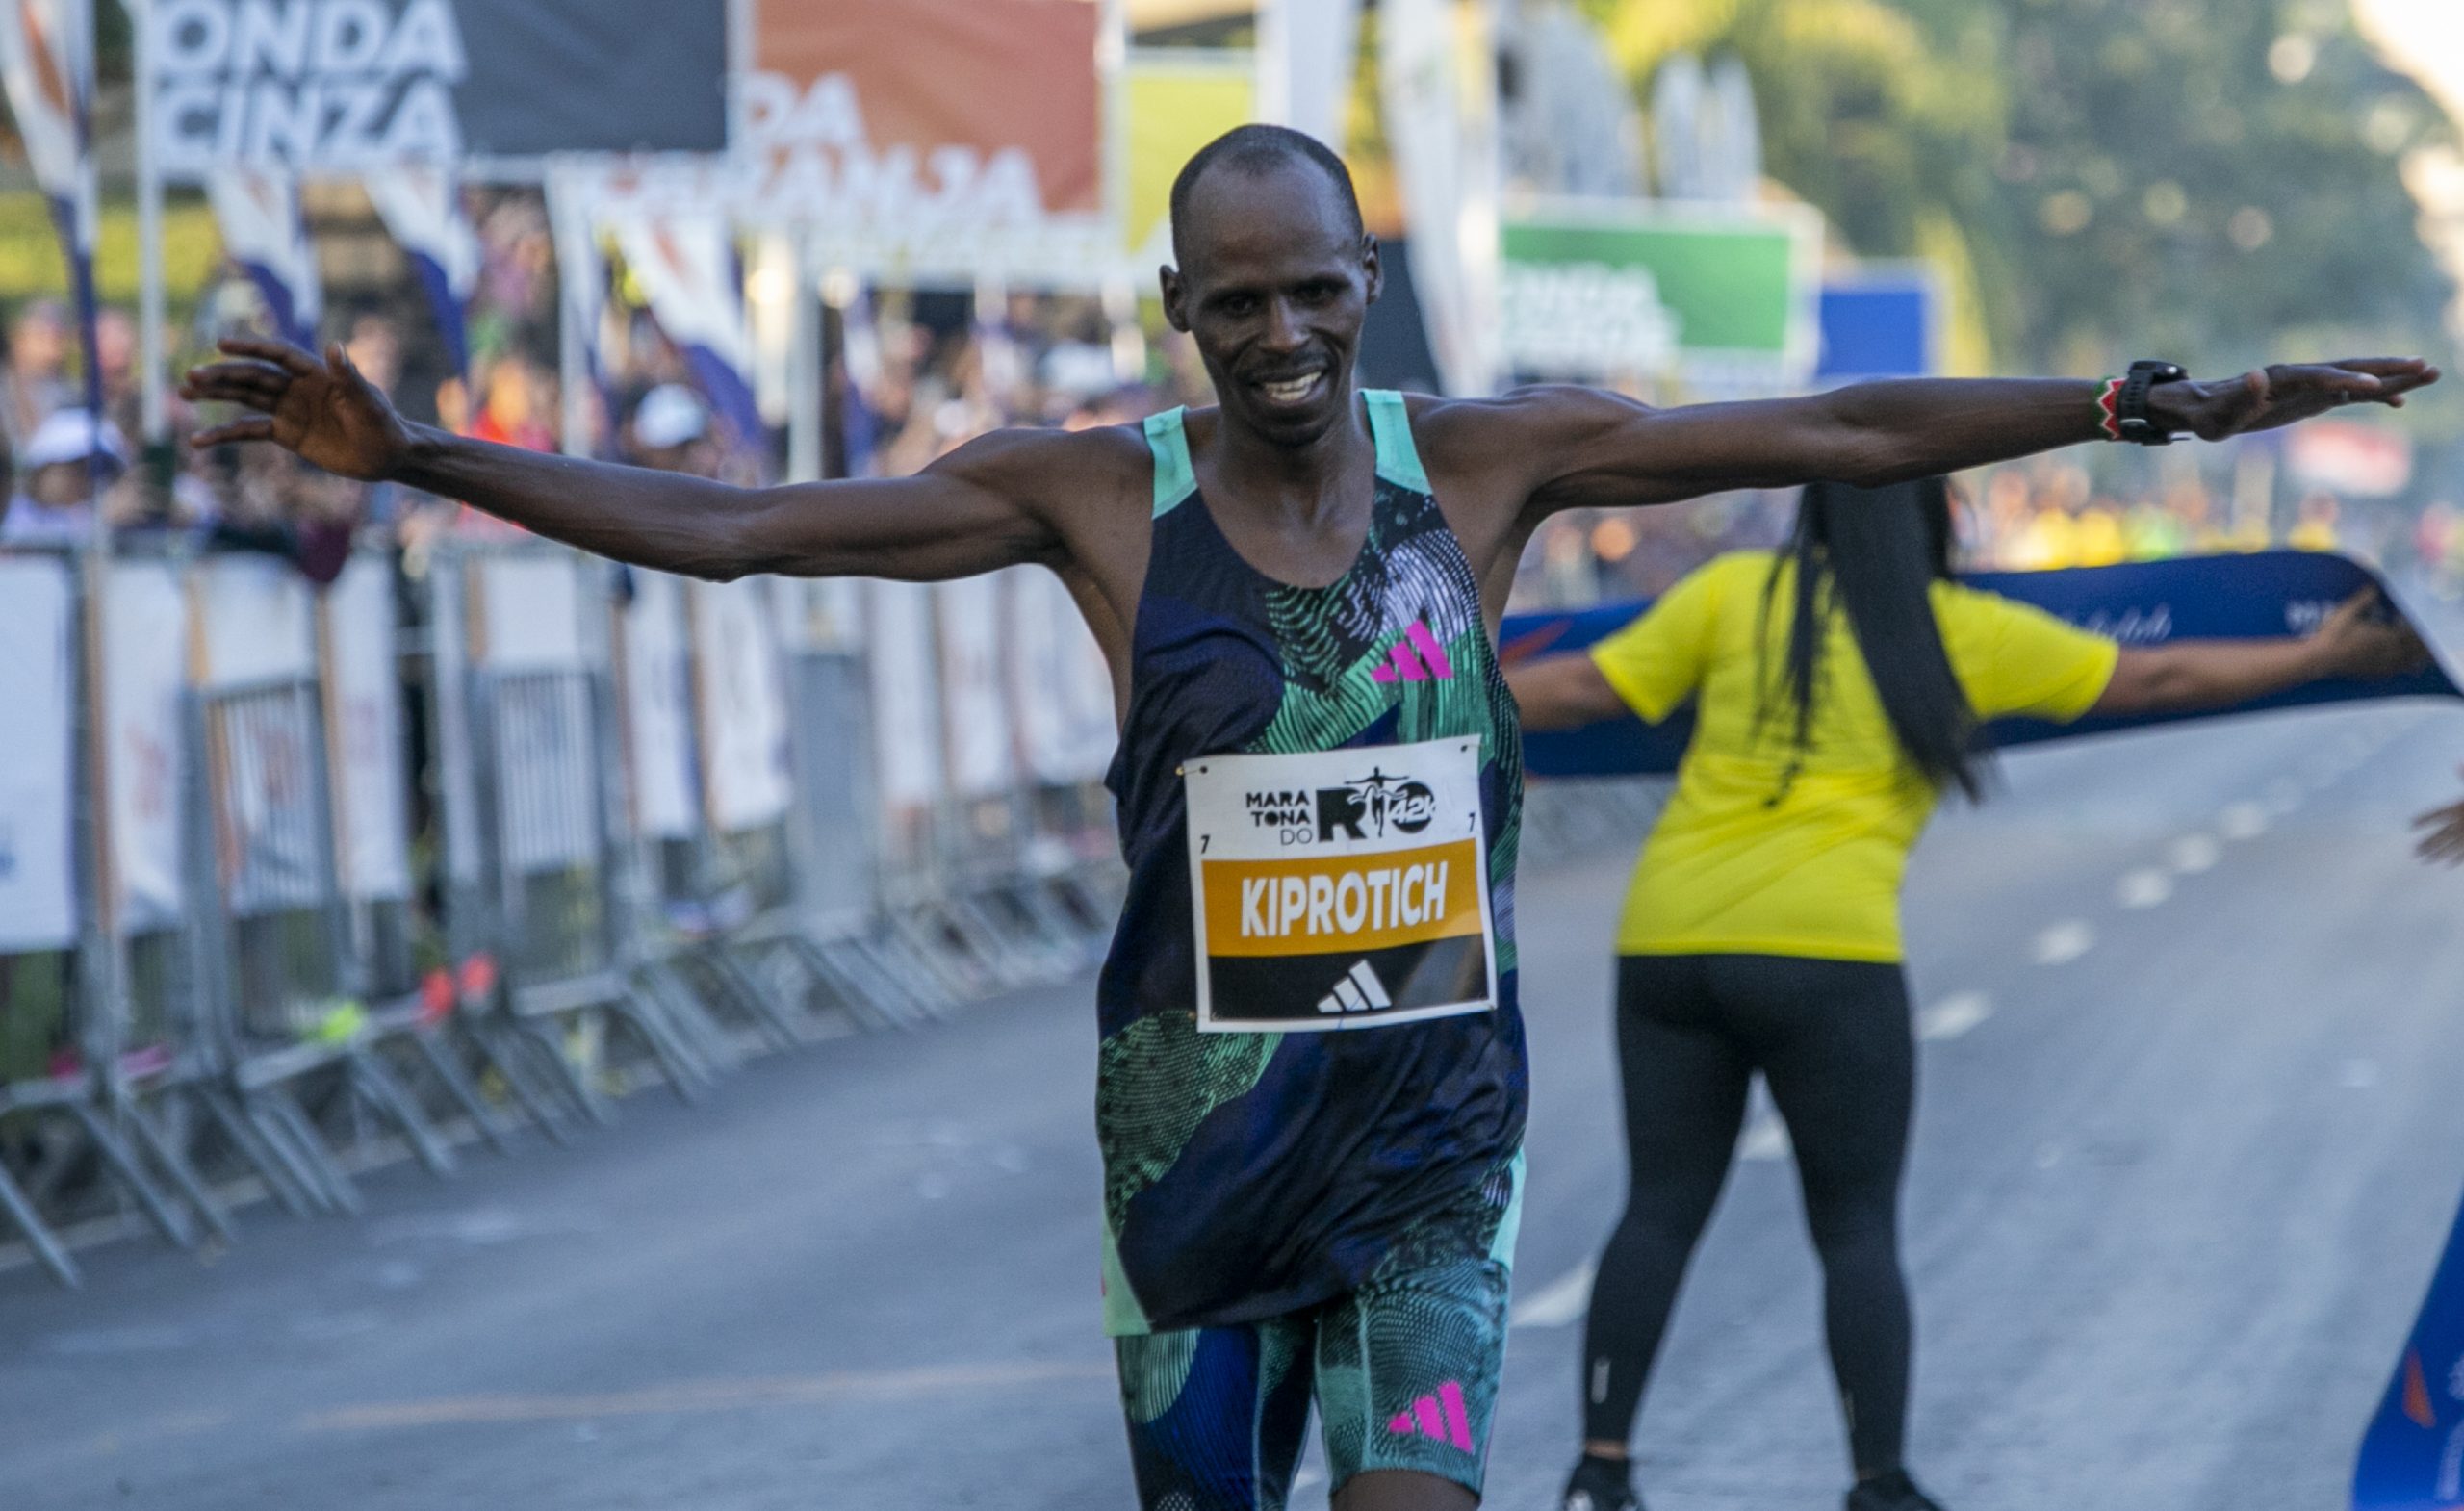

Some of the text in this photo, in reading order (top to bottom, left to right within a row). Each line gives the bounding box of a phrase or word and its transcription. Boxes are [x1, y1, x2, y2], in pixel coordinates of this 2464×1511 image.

[151, 0, 468, 77] ONDA
[152, 78, 464, 169] CINZA
[1245, 790, 1310, 808] MARA
[1251, 809, 1311, 827] TONA
[1200, 835, 1211, 855] 7
[1280, 828, 1313, 846] DO
[1241, 860, 1448, 938] KIPROTICH
